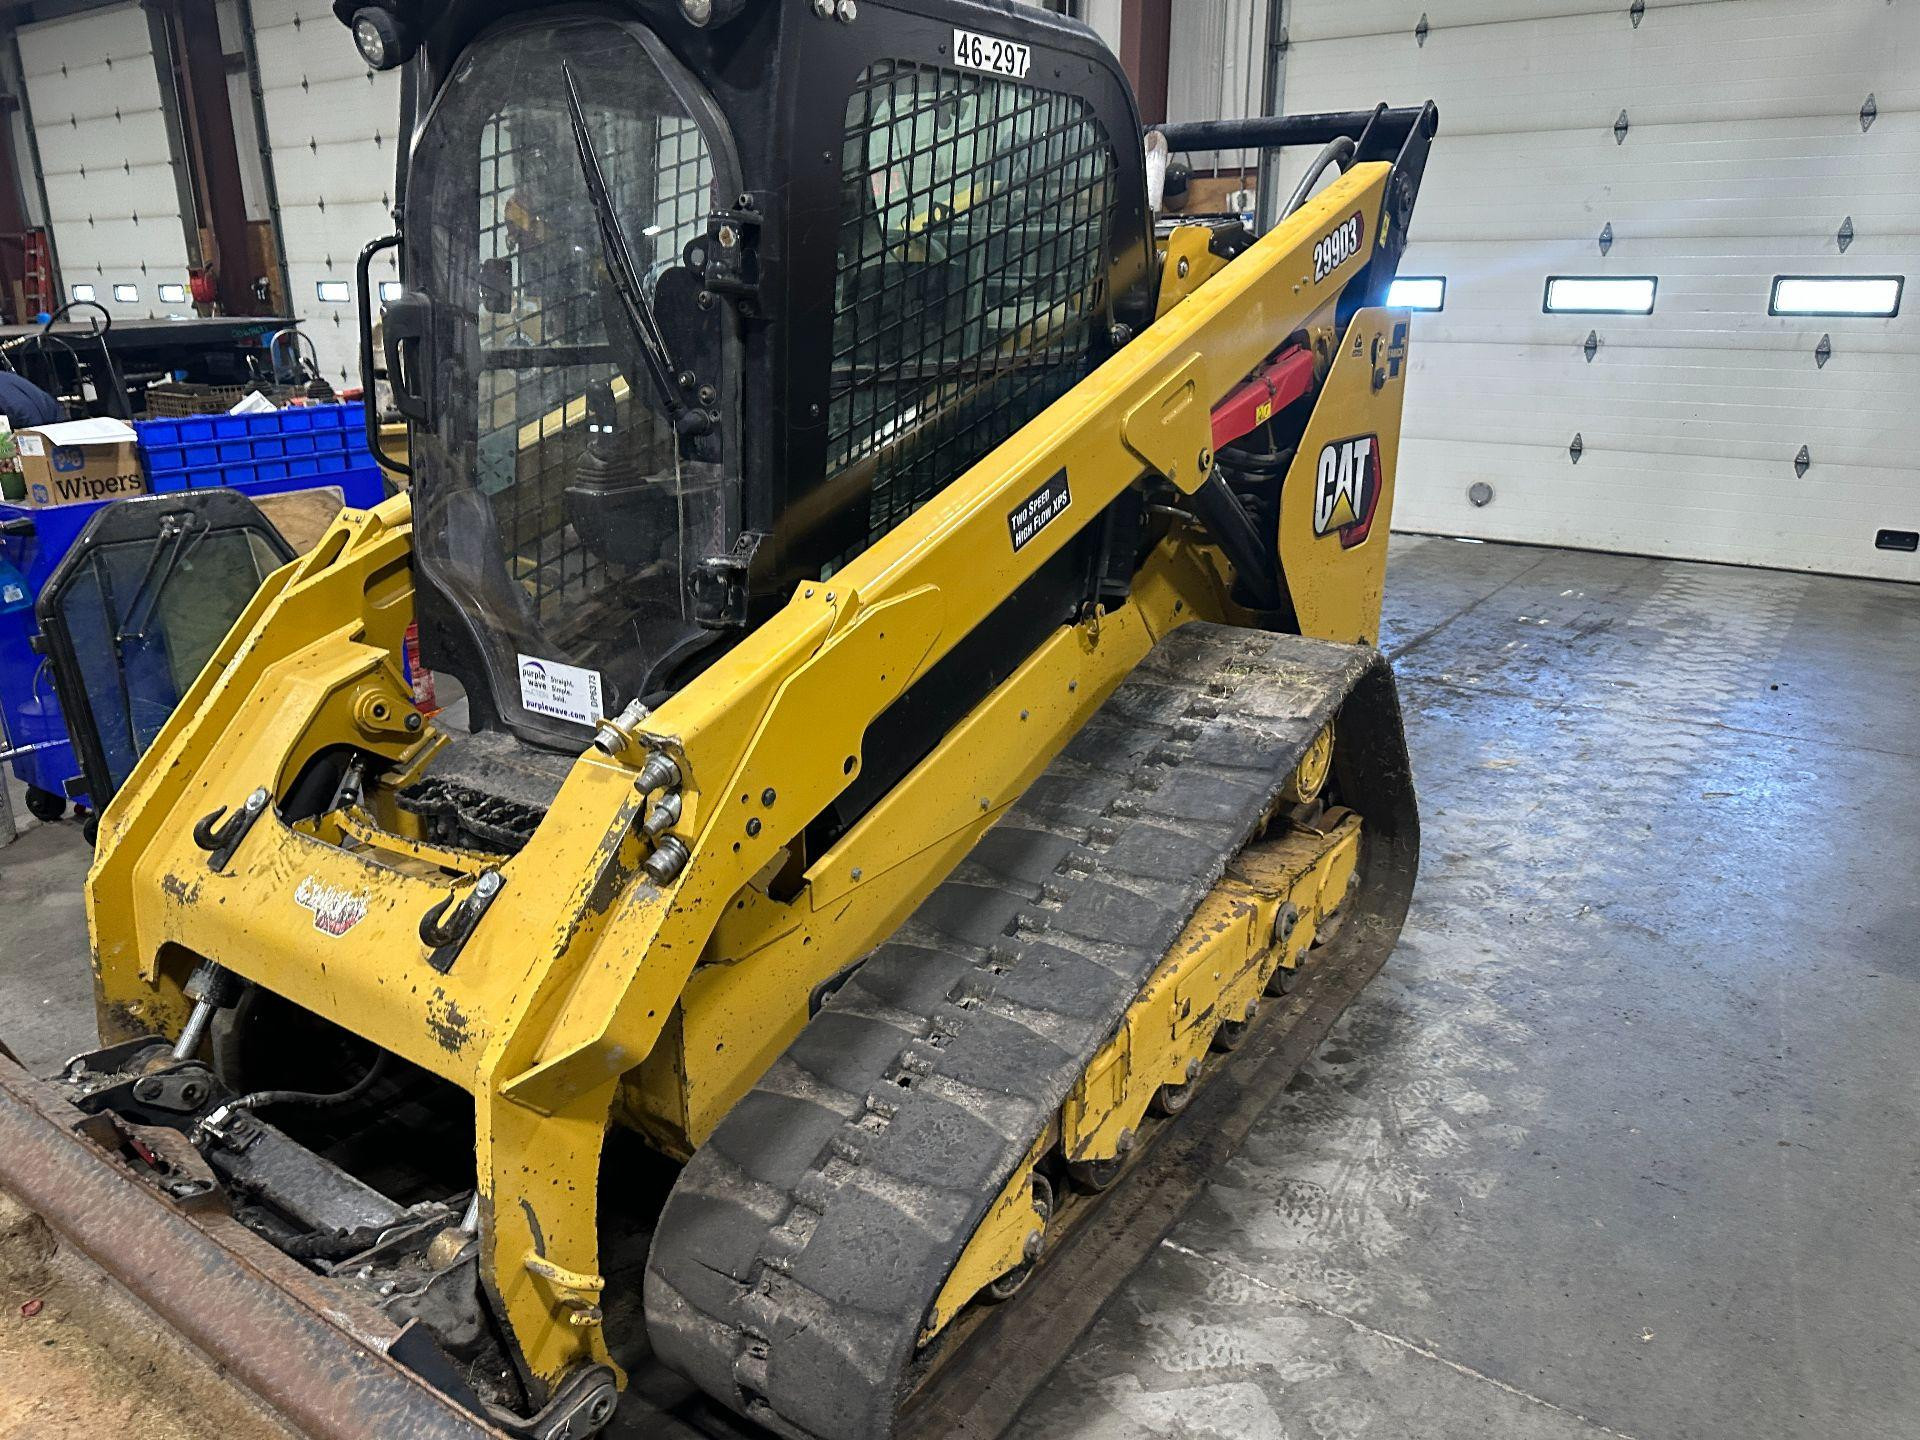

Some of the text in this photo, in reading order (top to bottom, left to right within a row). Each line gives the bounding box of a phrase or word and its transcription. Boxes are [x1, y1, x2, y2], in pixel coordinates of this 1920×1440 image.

[958, 33, 1026, 75] 46-297
[1313, 216, 1358, 283] 299D3
[56, 473, 140, 500] Wipers
[1315, 438, 1370, 533] CAT
[1053, 490, 1068, 513] XPS
[522, 669, 546, 680] purple
[527, 679, 547, 690] wave
[525, 699, 586, 721] purplewave.com
